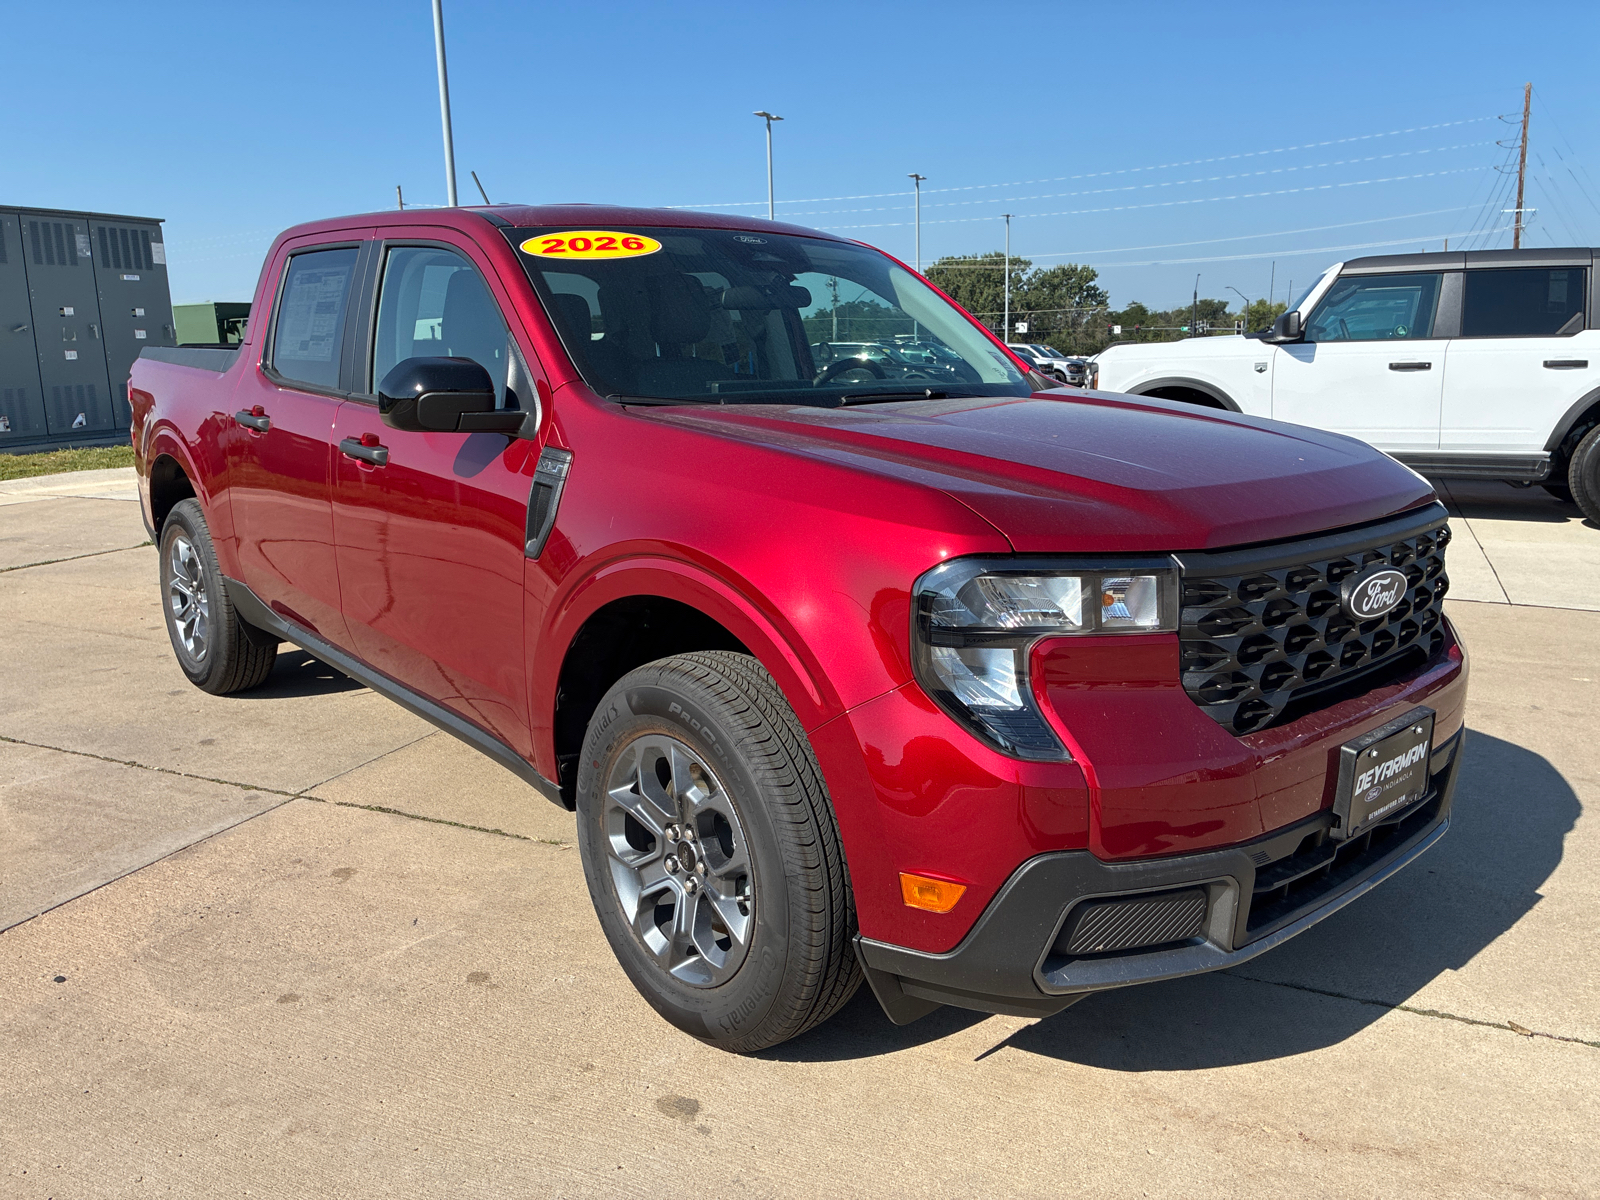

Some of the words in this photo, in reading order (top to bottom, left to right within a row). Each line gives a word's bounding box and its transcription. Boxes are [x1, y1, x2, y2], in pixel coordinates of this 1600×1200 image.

[541, 236, 646, 254] 2026
[1362, 577, 1399, 612] Ford
[1354, 740, 1429, 797] DEYARMAN
[1383, 772, 1413, 791] INDIANOLA
[1366, 787, 1381, 801] Ford
